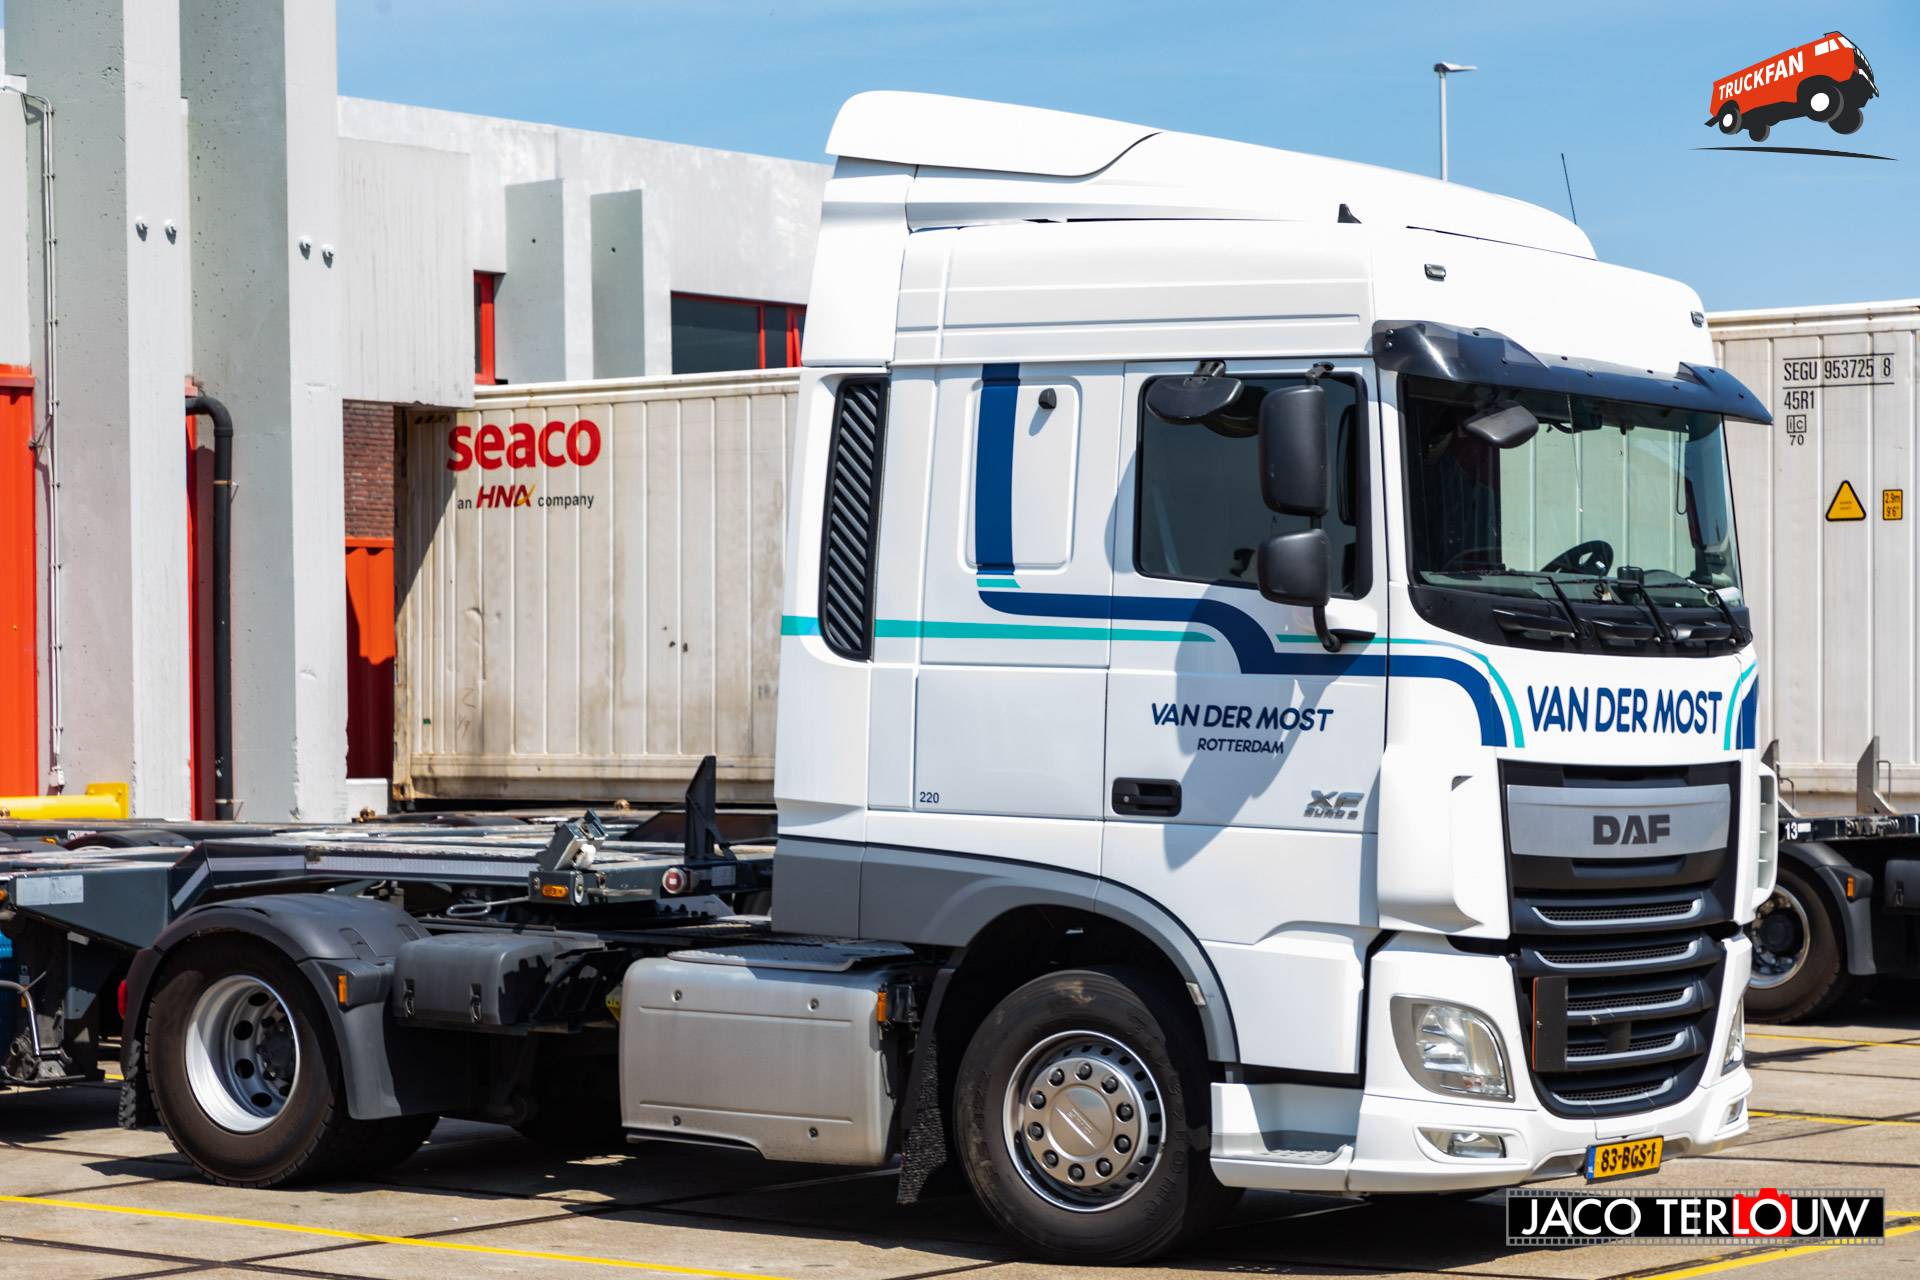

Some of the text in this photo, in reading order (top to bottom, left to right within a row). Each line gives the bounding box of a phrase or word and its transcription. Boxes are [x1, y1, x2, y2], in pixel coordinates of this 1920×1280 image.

[1783, 357, 1892, 381] SEGU 953725 8
[1783, 390, 1815, 410] 45R1
[446, 419, 602, 472] seaco
[1789, 434, 1805, 446] 70
[457, 484, 594, 510] an HNA company
[1151, 702, 1334, 732] VAN DER MOST
[1527, 685, 1723, 735] VAN DER MOST
[1197, 737, 1284, 754] ROTTERDAM
[919, 791, 940, 804] 220
[1593, 814, 1670, 845] DAF
[1785, 822, 1798, 840] 13
